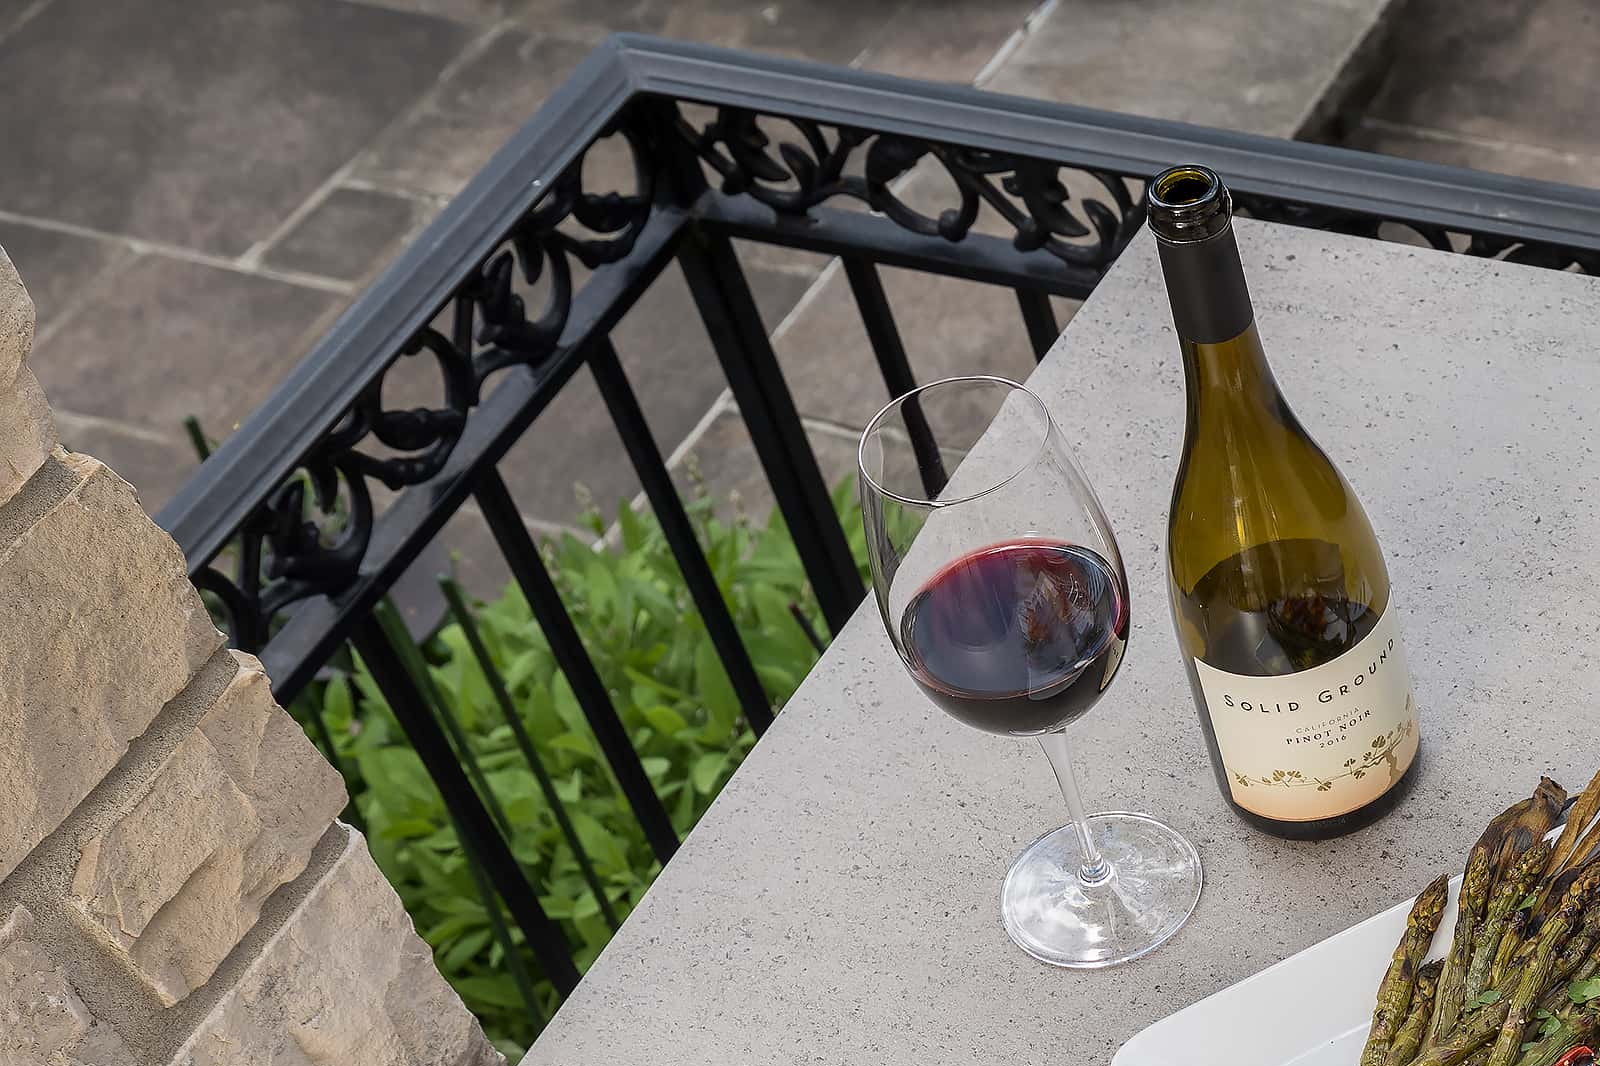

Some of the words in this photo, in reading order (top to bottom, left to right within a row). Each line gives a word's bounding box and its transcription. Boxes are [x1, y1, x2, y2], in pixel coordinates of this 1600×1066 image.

[1223, 694, 1300, 713] SOLID
[1318, 638, 1394, 703] GROUND
[1286, 729, 1333, 745] PINOT
[1339, 709, 1373, 732] NOIR
[1295, 706, 1360, 734] CALIFORNIA
[1319, 735, 1348, 749] 2016
